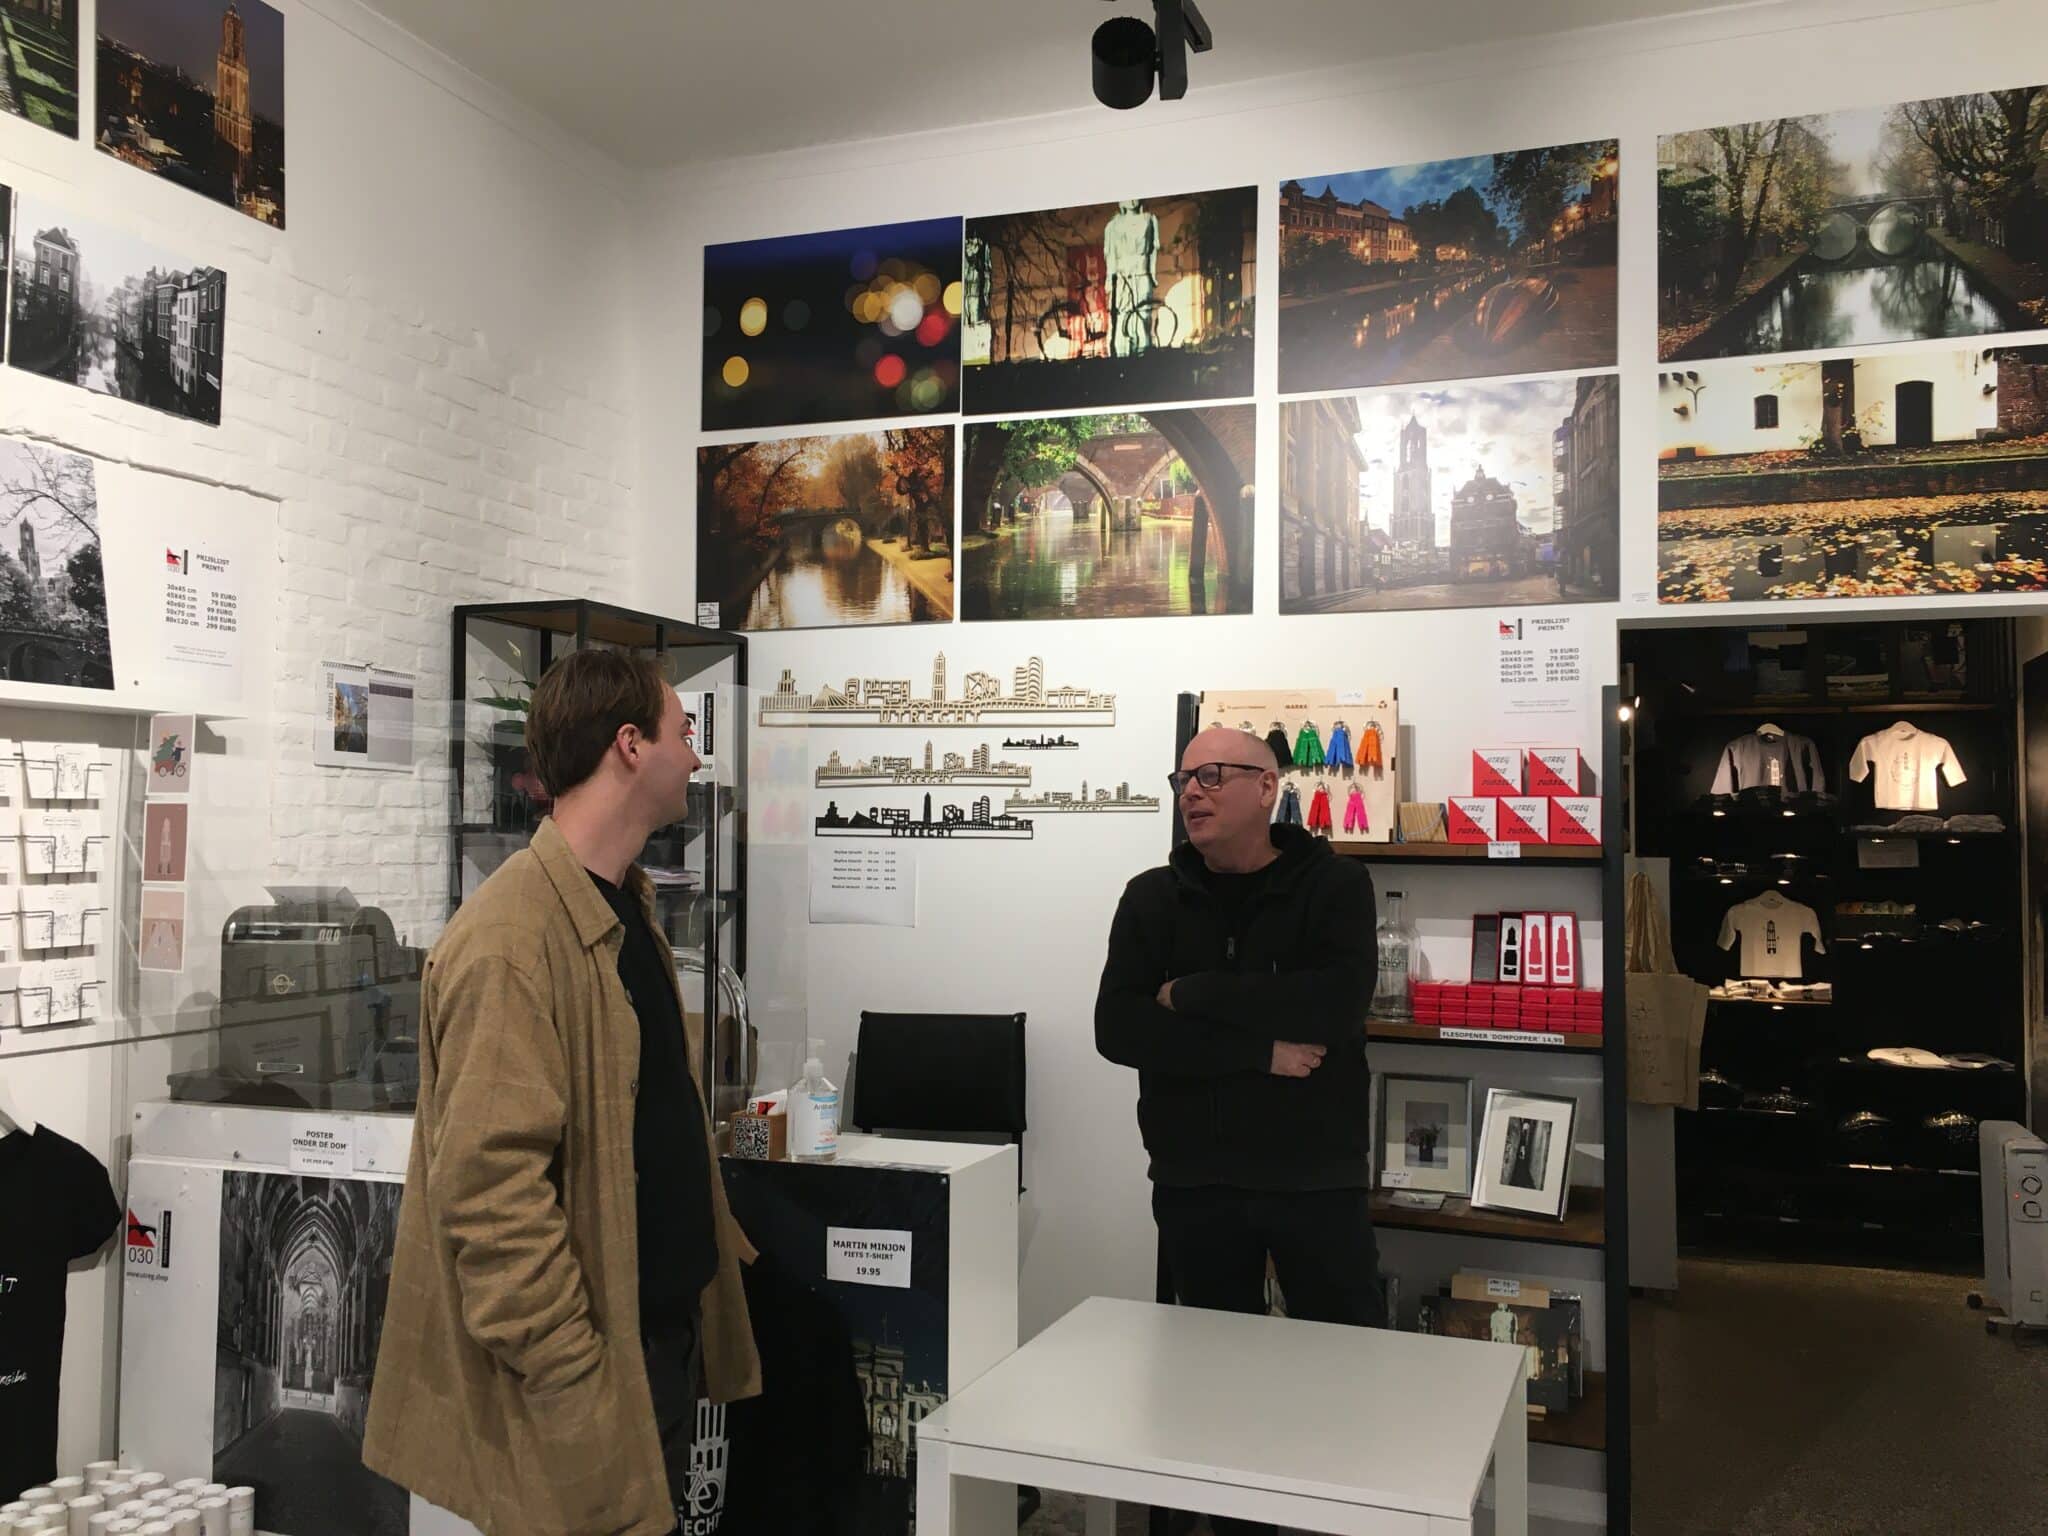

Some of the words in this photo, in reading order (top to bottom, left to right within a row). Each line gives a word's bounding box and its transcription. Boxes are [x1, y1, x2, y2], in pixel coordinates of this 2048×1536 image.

[201, 563, 224, 572] PRINTS
[220, 593, 237, 601] EURO
[220, 601, 237, 609] EURO
[216, 608, 233, 616] EURO
[219, 616, 237, 625] EURO
[219, 624, 237, 632] EURO
[880, 709, 981, 724] UTRECHT
[892, 775, 953, 784] UTRECHT
[891, 828, 952, 838] UTRECHT
[1442, 1031, 1488, 1039] FLESOPENER
[306, 1130, 334, 1139] POSTER
[292, 1138, 317, 1147] ONDER
[330, 1142, 346, 1150] DOM
[833, 1240, 868, 1250] MARTIN
[870, 1242, 906, 1252] MINJON
[128, 1247, 154, 1265] 030
[843, 1250, 864, 1258] FIETS
[865, 1252, 894, 1261] T-SHIRT
[856, 1266, 881, 1276] 19.95
